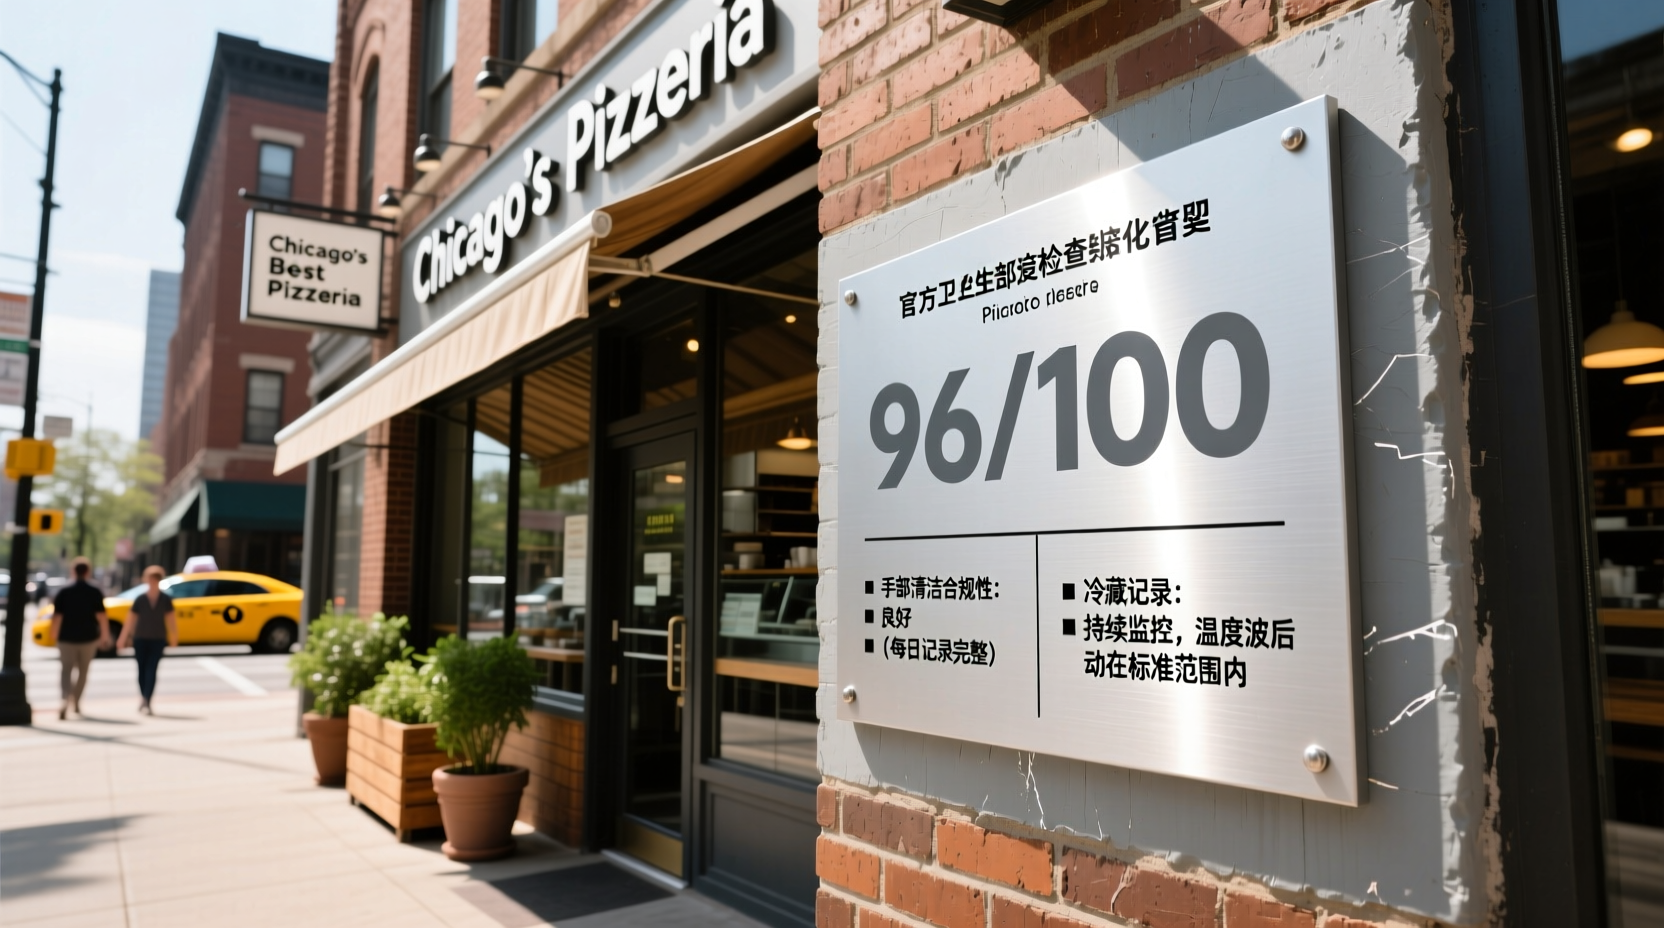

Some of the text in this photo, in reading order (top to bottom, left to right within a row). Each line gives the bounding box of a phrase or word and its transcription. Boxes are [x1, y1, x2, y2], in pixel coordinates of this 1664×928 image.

[413, 0, 764, 303] Chicago's Pizzeria
[269, 235, 368, 264] Chicago's
[270, 257, 325, 281] Best
[268, 279, 361, 307] Pizzeria
[869, 311, 1270, 490] 96/100
[882, 606, 912, 629] 良好
[1083, 649, 1247, 688] 动在标准范围内
